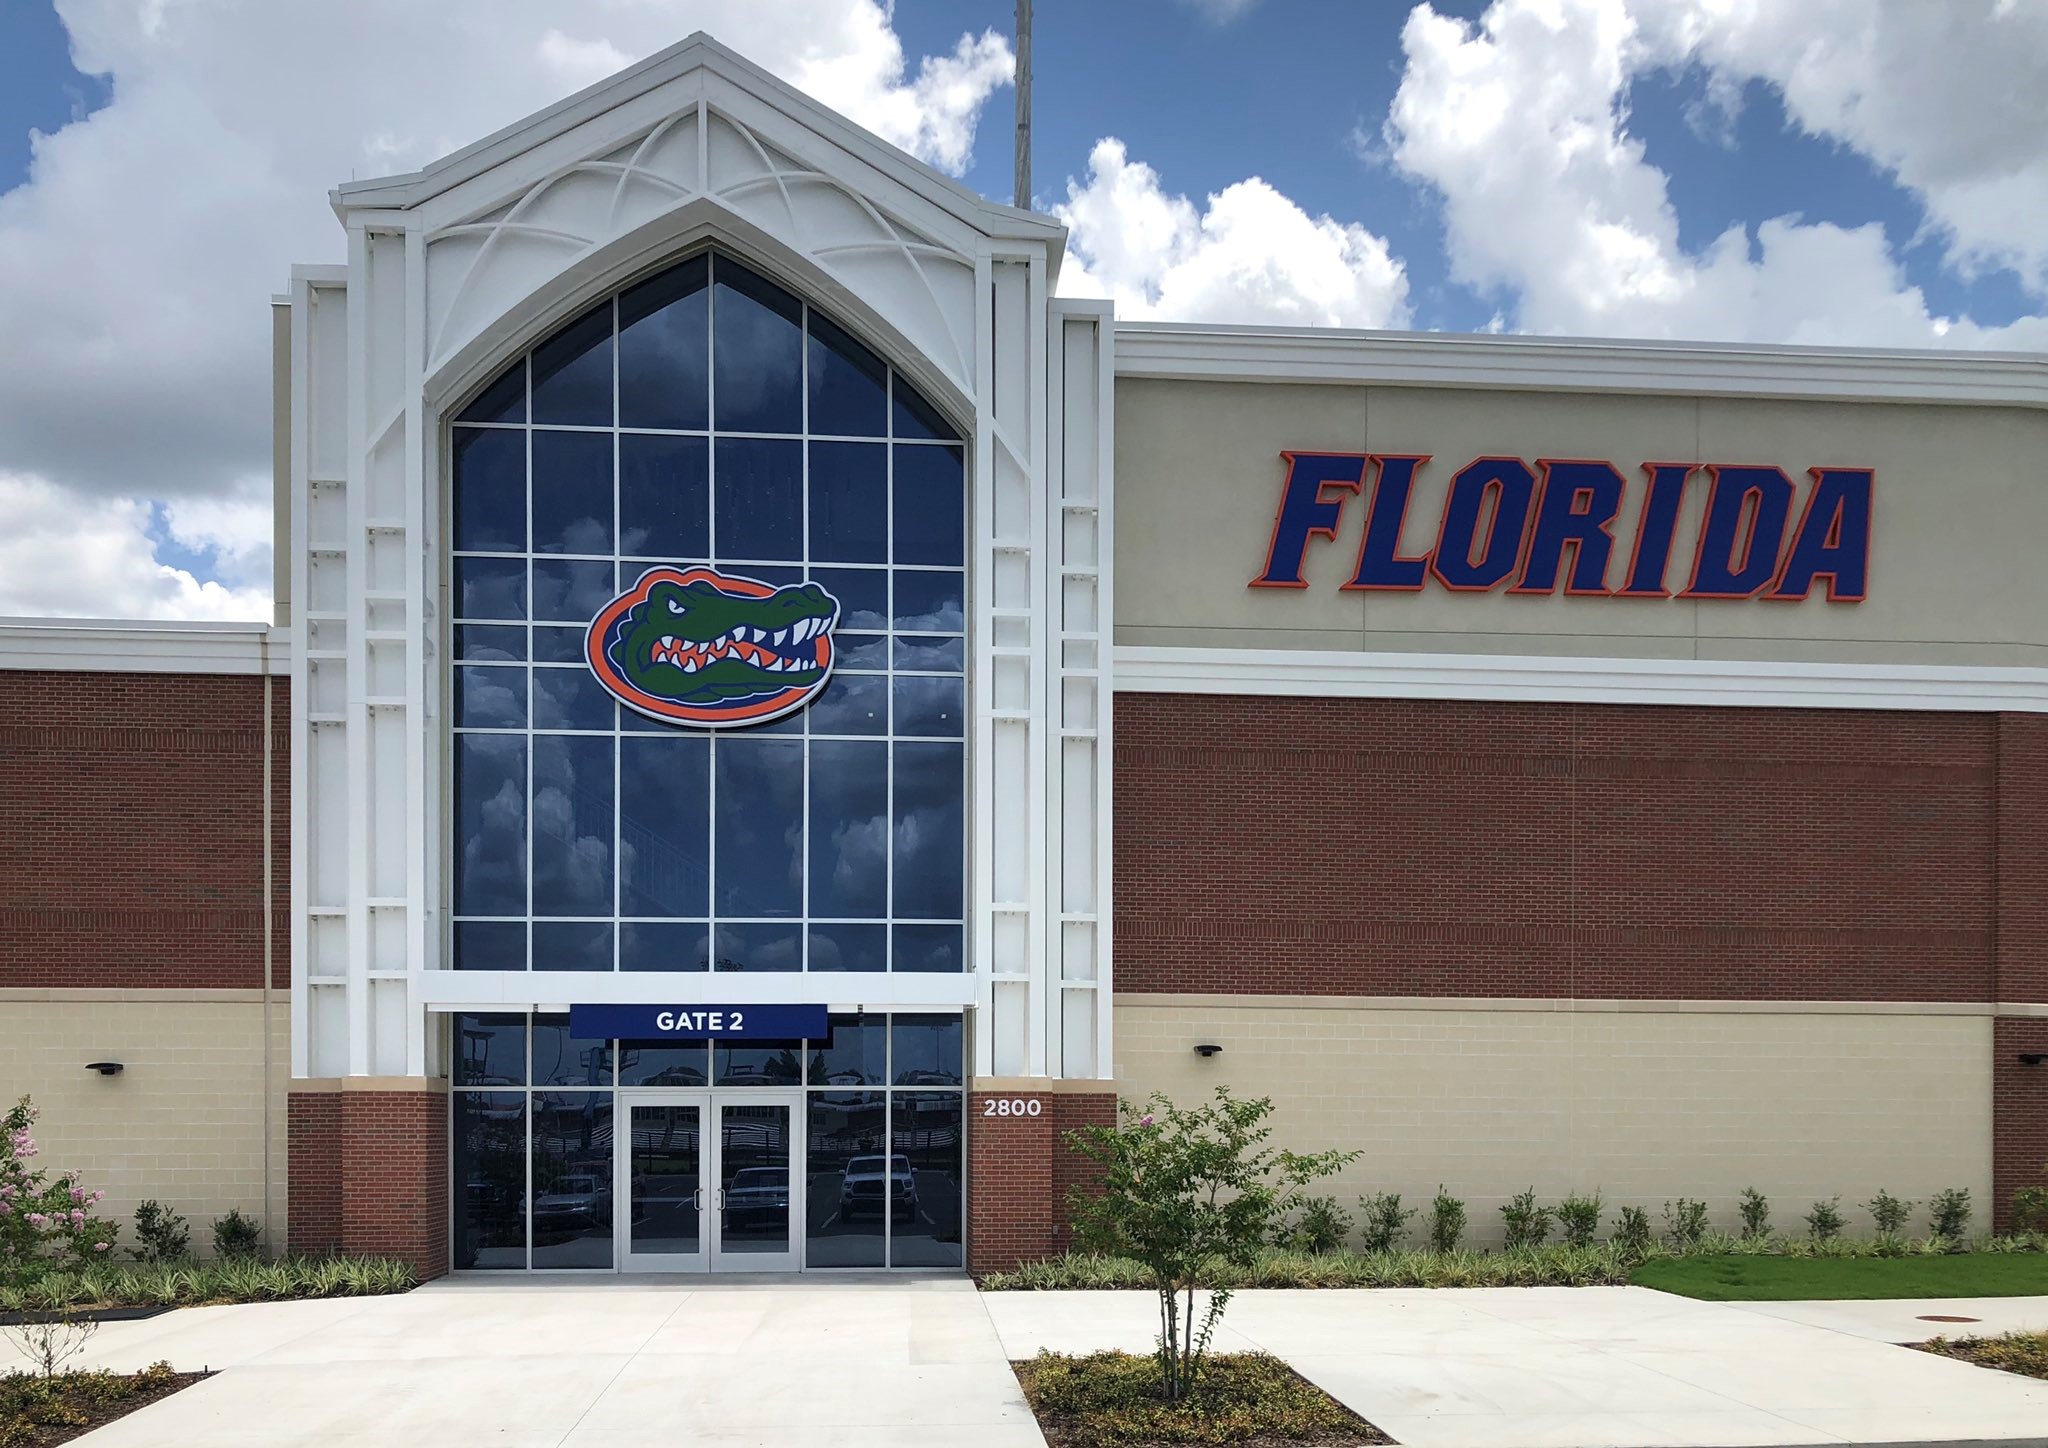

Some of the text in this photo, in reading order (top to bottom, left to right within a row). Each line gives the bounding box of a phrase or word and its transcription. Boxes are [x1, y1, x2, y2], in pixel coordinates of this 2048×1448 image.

[1248, 451, 1875, 603] FLORIDA
[656, 1012, 743, 1031] GATE 2
[983, 1099, 1042, 1116] 2800
